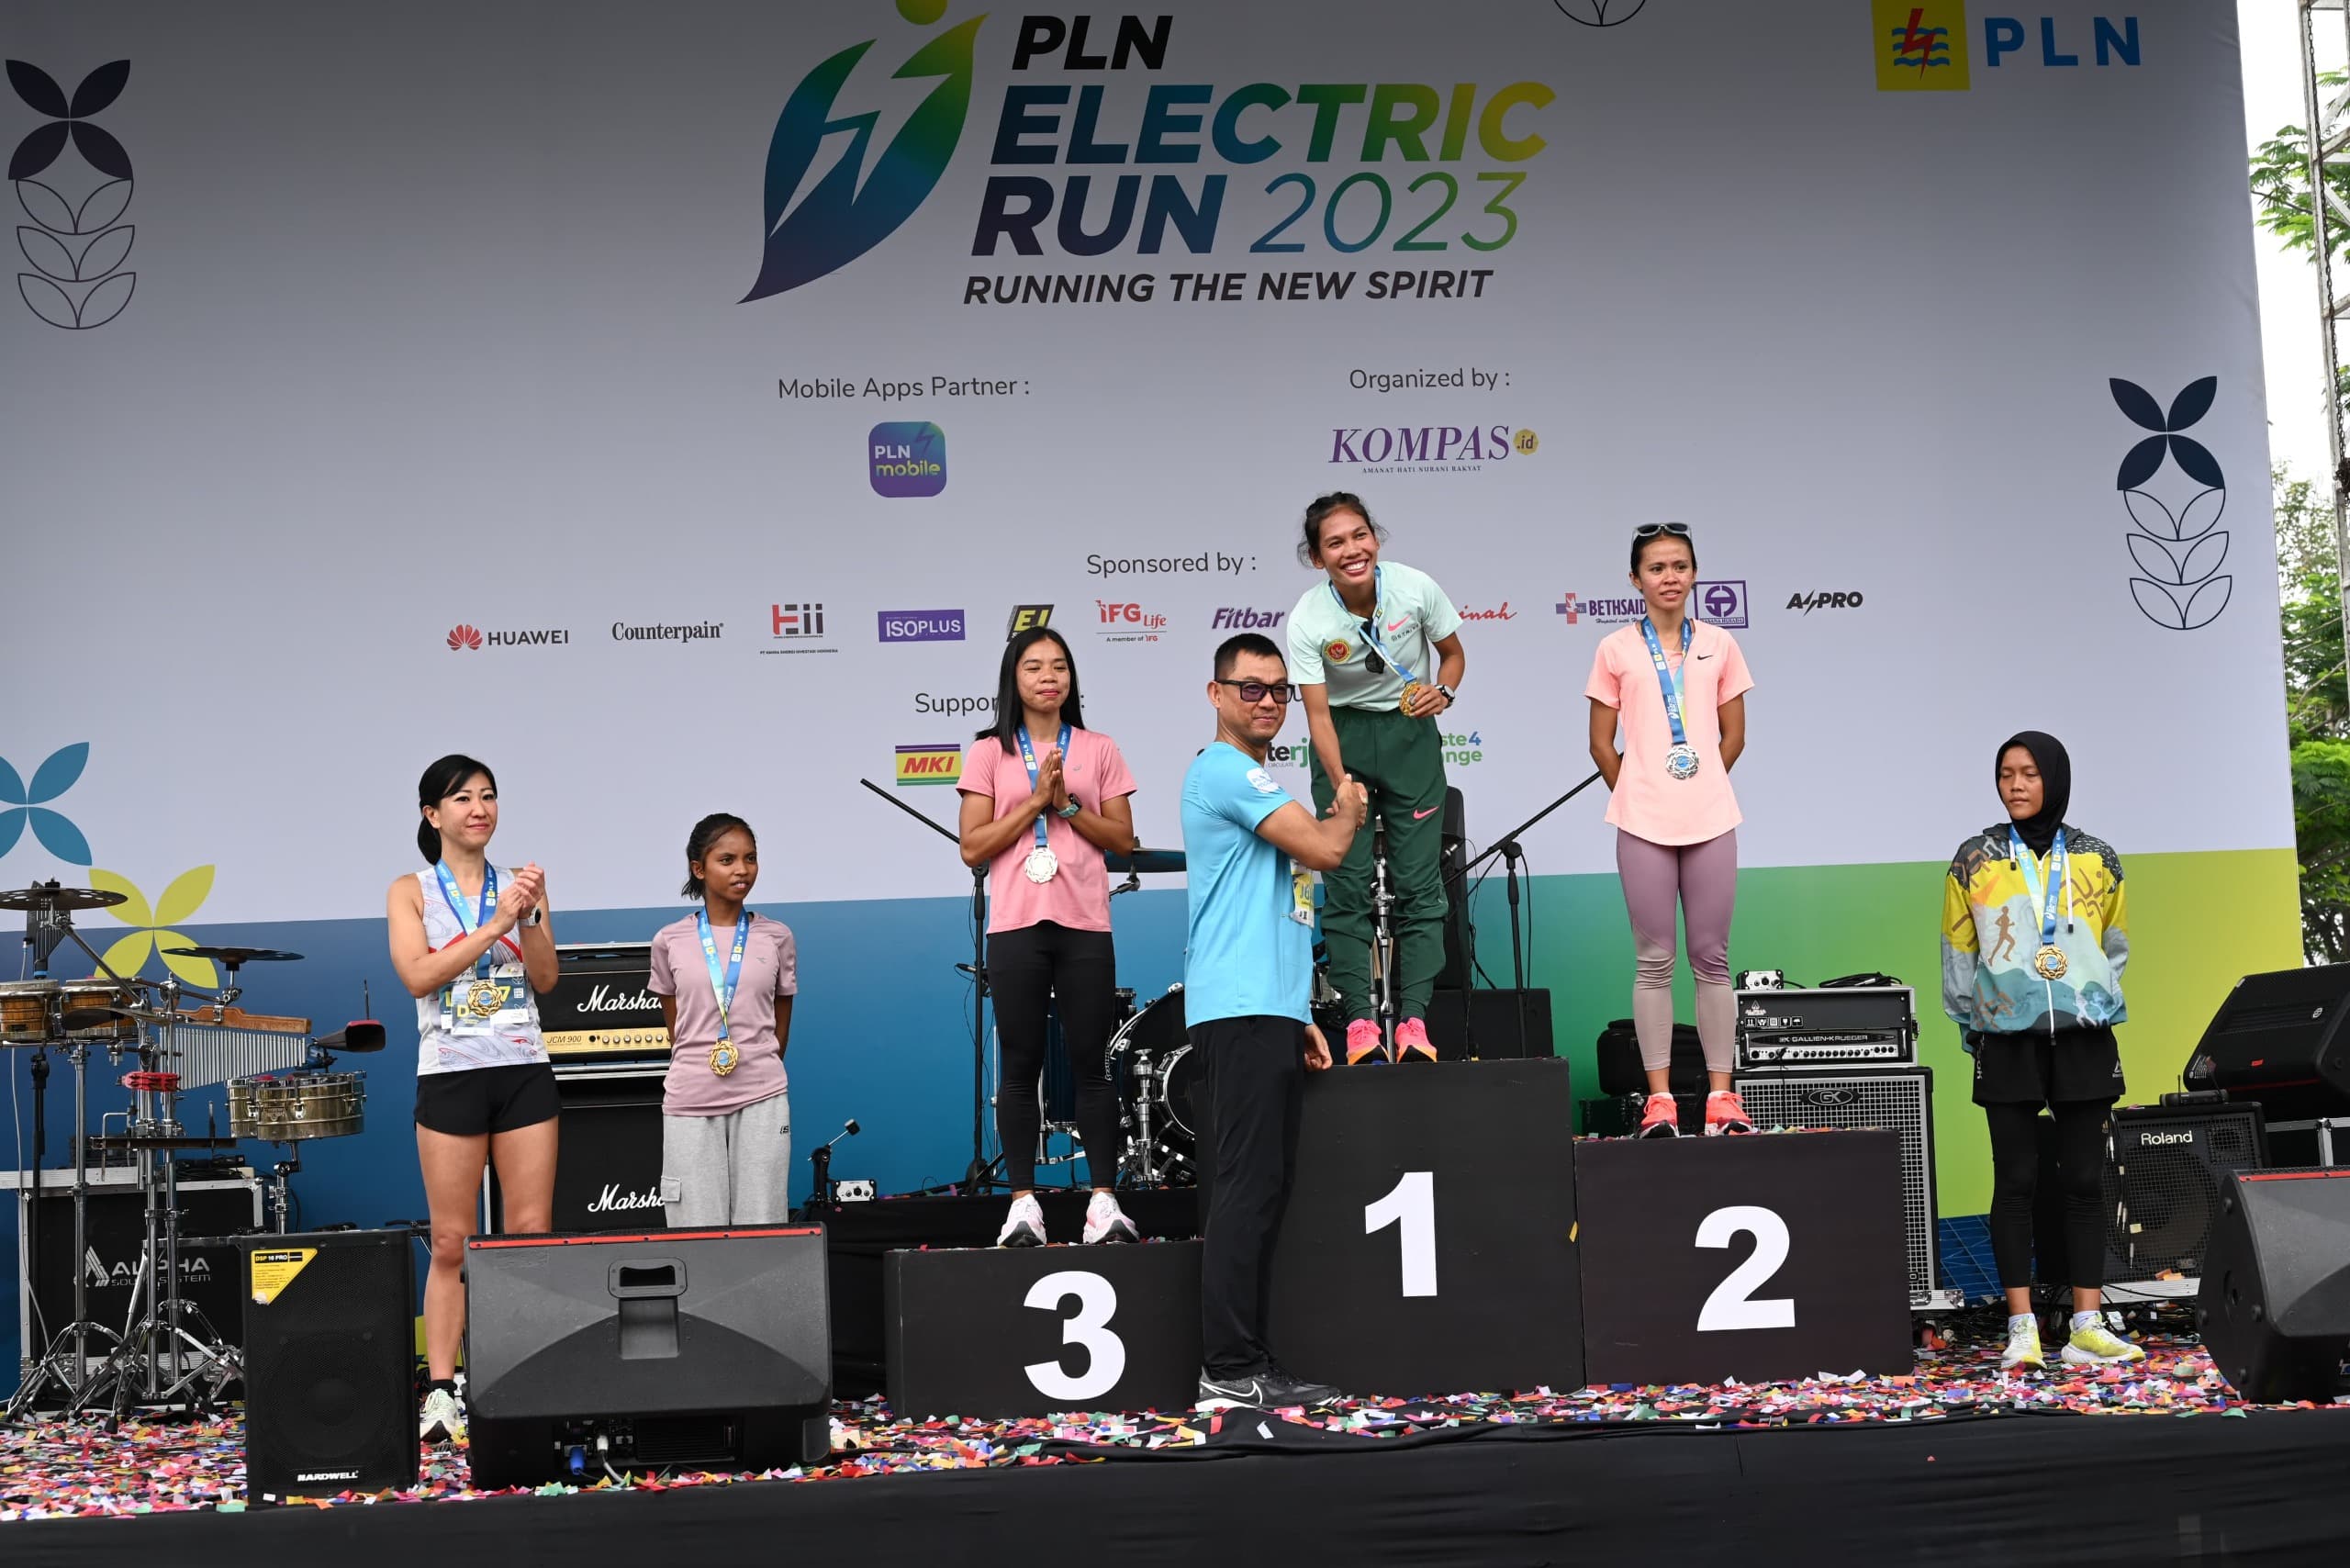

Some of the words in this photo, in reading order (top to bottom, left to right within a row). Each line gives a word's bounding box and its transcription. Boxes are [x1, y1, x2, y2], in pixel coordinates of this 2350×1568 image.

[1012, 15, 1173, 70] PLN
[1984, 17, 2141, 67] PLN
[990, 82, 1556, 164] ELECTRIC
[970, 174, 1227, 257] RUN
[1249, 171, 1528, 254] 2023
[963, 273, 1158, 305] RUNNING
[1169, 273, 1246, 302] THE
[1258, 272, 1356, 301] NEW
[1365, 269, 1494, 299] SPIRIT
[778, 378, 855, 398] Mobile
[863, 377, 923, 401] Apps
[932, 376, 1017, 397] Partner
[1349, 368, 1463, 393] Organized
[1472, 368, 1498, 391] by
[875, 445, 911, 459] PLN
[1328, 425, 1510, 464] KOMPAS
[876, 460, 941, 477] mobile
[1087, 554, 1209, 578] Sponsored
[1216, 553, 1244, 576] by
[1212, 606, 1284, 630] Fitbar
[1589, 599, 1647, 617] BETHSAID
[611, 621, 722, 643] Counterpain
[886, 620, 961, 637] ISOPLUS
[1143, 614, 1167, 630] Life
[487, 630, 569, 646] HUAWEI
[915, 693, 999, 717] Suppor
[1442, 731, 1482, 746] ste4
[903, 756, 955, 774] MKI
[1446, 751, 1483, 767] nge
[577, 984, 663, 1013] Marsha
[1820, 1092, 1841, 1103] GK
[2141, 1130, 2193, 1145] Roland
[1364, 1170, 1438, 1297] 1
[1695, 1205, 1796, 1332] 2
[1023, 1271, 1126, 1401] 3
